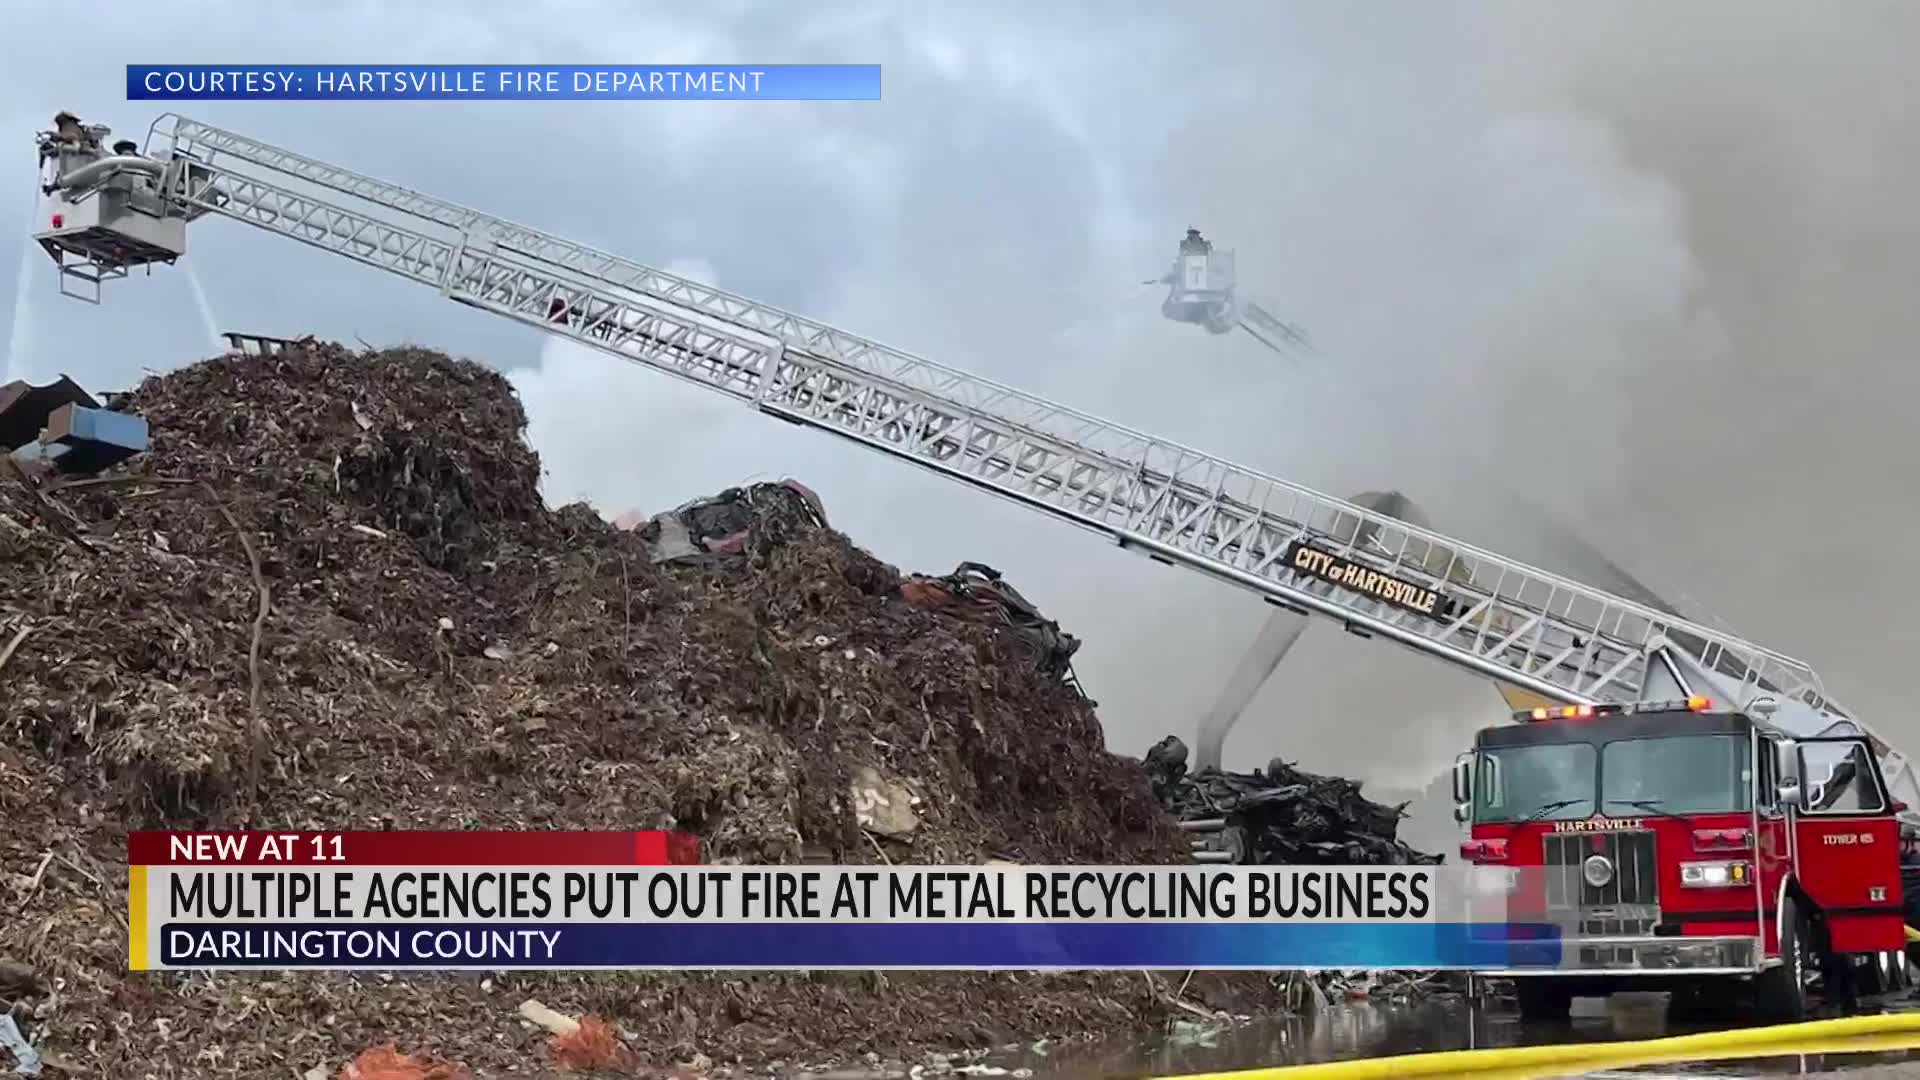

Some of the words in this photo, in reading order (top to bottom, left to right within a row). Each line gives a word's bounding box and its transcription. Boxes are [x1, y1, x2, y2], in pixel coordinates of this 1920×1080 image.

[1295, 547, 1334, 574] CITY
[1342, 563, 1438, 613] HARTSVILLE
[1554, 819, 1643, 832] HARTSVILLE
